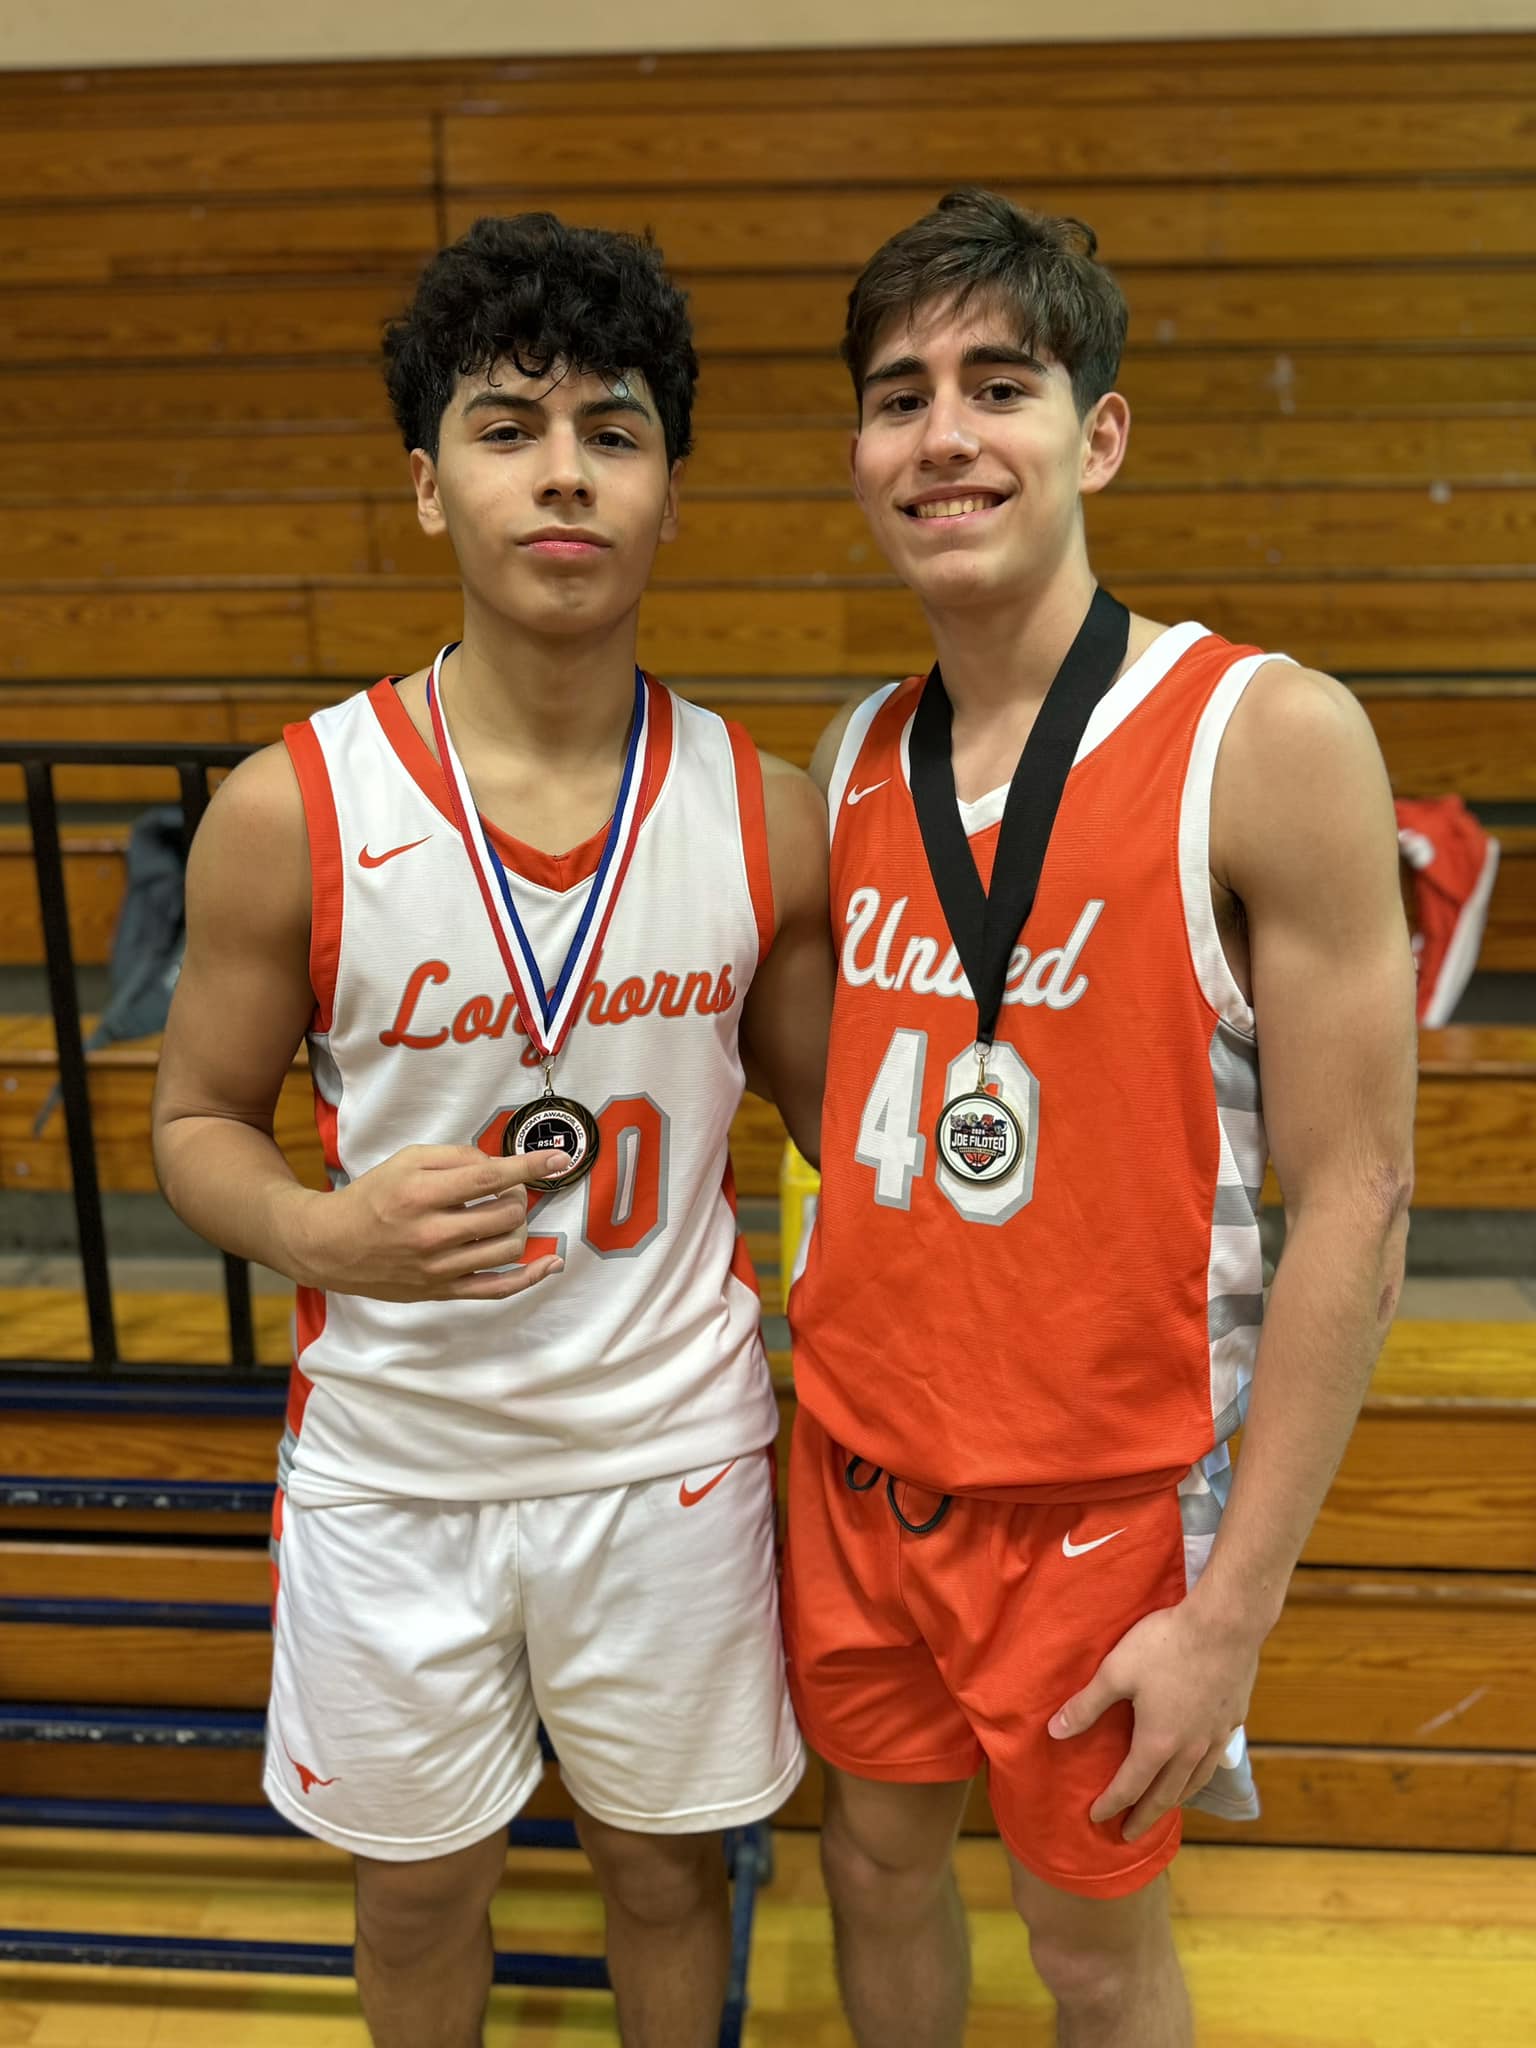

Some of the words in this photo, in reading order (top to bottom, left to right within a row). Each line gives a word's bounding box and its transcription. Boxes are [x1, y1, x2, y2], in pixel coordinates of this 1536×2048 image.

[842, 886, 1105, 1010] Unied
[379, 960, 736, 1068] Lonhorns
[517, 1114, 542, 1147] ECONOMY
[854, 1026, 1040, 1226] 40
[951, 1132, 968, 1147] JOE
[969, 1135, 1005, 1152] FILOTEO
